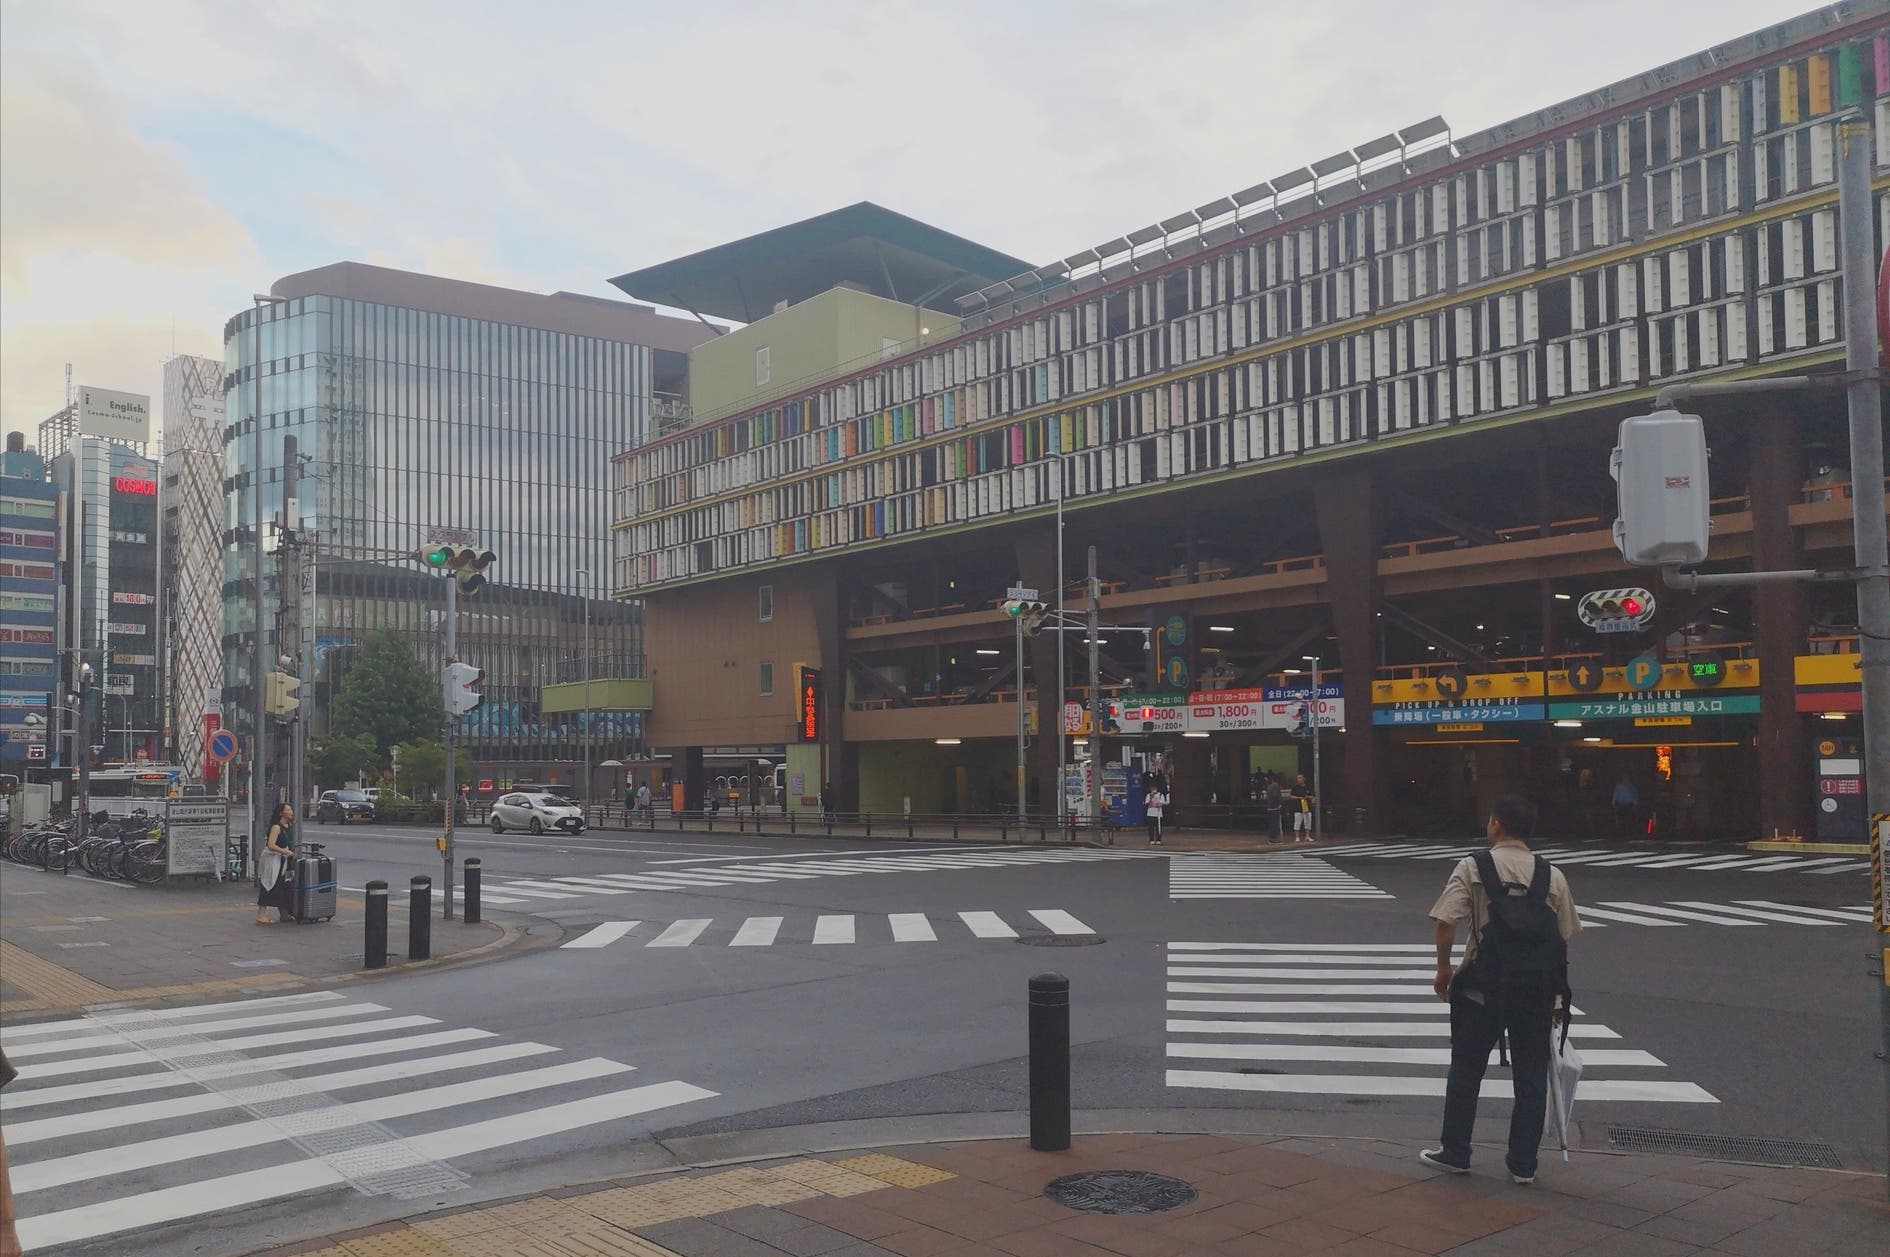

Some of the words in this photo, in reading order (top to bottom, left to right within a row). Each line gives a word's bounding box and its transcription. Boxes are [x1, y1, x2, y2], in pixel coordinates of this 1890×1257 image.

[1636, 663, 1650, 684] P
[1693, 664, 1717, 676] 空車
[1618, 691, 1682, 701] PARKING
[1427, 701, 1440, 709] UP
[1462, 699, 1491, 707] DROP
[1499, 698, 1519, 706] OFF
[1581, 700, 1723, 715] アスナル金山駐車場入口
